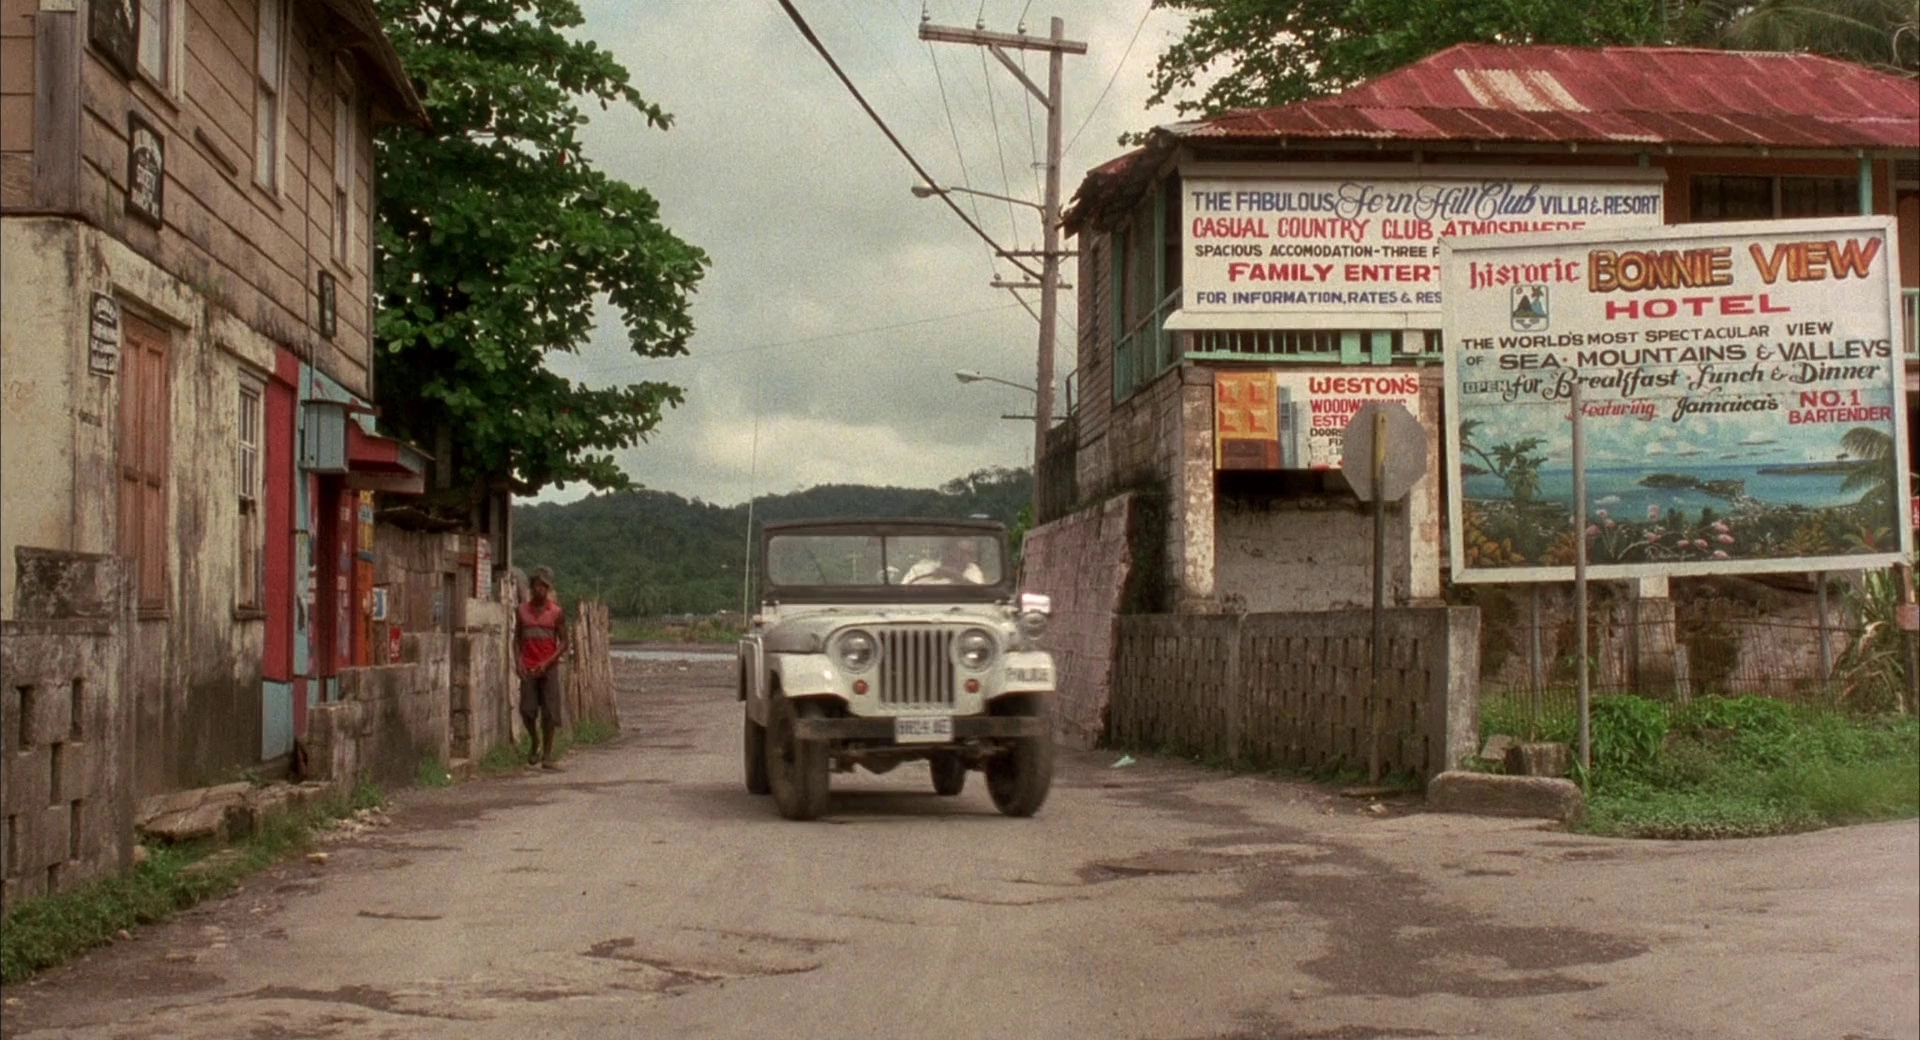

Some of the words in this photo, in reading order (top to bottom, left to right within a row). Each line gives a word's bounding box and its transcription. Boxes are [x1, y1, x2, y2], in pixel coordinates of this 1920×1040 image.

[1192, 191, 1231, 213] THE
[1236, 191, 1334, 213] FABULOUS
[1335, 183, 1413, 220] Fern
[1413, 184, 1478, 221] Hill
[1475, 183, 1540, 220] Club
[1540, 195, 1588, 214] VILLA
[1590, 198, 1602, 214] &
[1603, 194, 1661, 214] RESORT
[1193, 217, 1269, 239] CASUAL
[1277, 217, 1371, 243] COUNTRY
[1382, 219, 1434, 240] CLUB
[1195, 244, 1263, 257] SPACIOUS
[1228, 263, 1334, 282] FAMILY
[1588, 246, 1733, 293] BONNIE
[1748, 236, 1882, 285] VIEW
[1197, 291, 1227, 304] FOR
[1605, 293, 1791, 321] HOTEL
[1462, 338, 1494, 350] THE
[1499, 331, 1584, 349] WORLD'S
[1588, 331, 1639, 345] MOST
[1645, 325, 1769, 343] SPECTACULAR
[1787, 321, 1833, 337] VIEW
[1466, 356, 1484, 366] OF
[1577, 344, 1747, 368] MOUNTAINS
[1756, 344, 1774, 360] &
[1777, 339, 1891, 362] VALLEYS
[1309, 374, 1420, 395] WESTON'S
[1463, 380, 1511, 394] OPEN
[1503, 374, 1544, 402] for
[1789, 406, 1892, 424] BARTENDER
